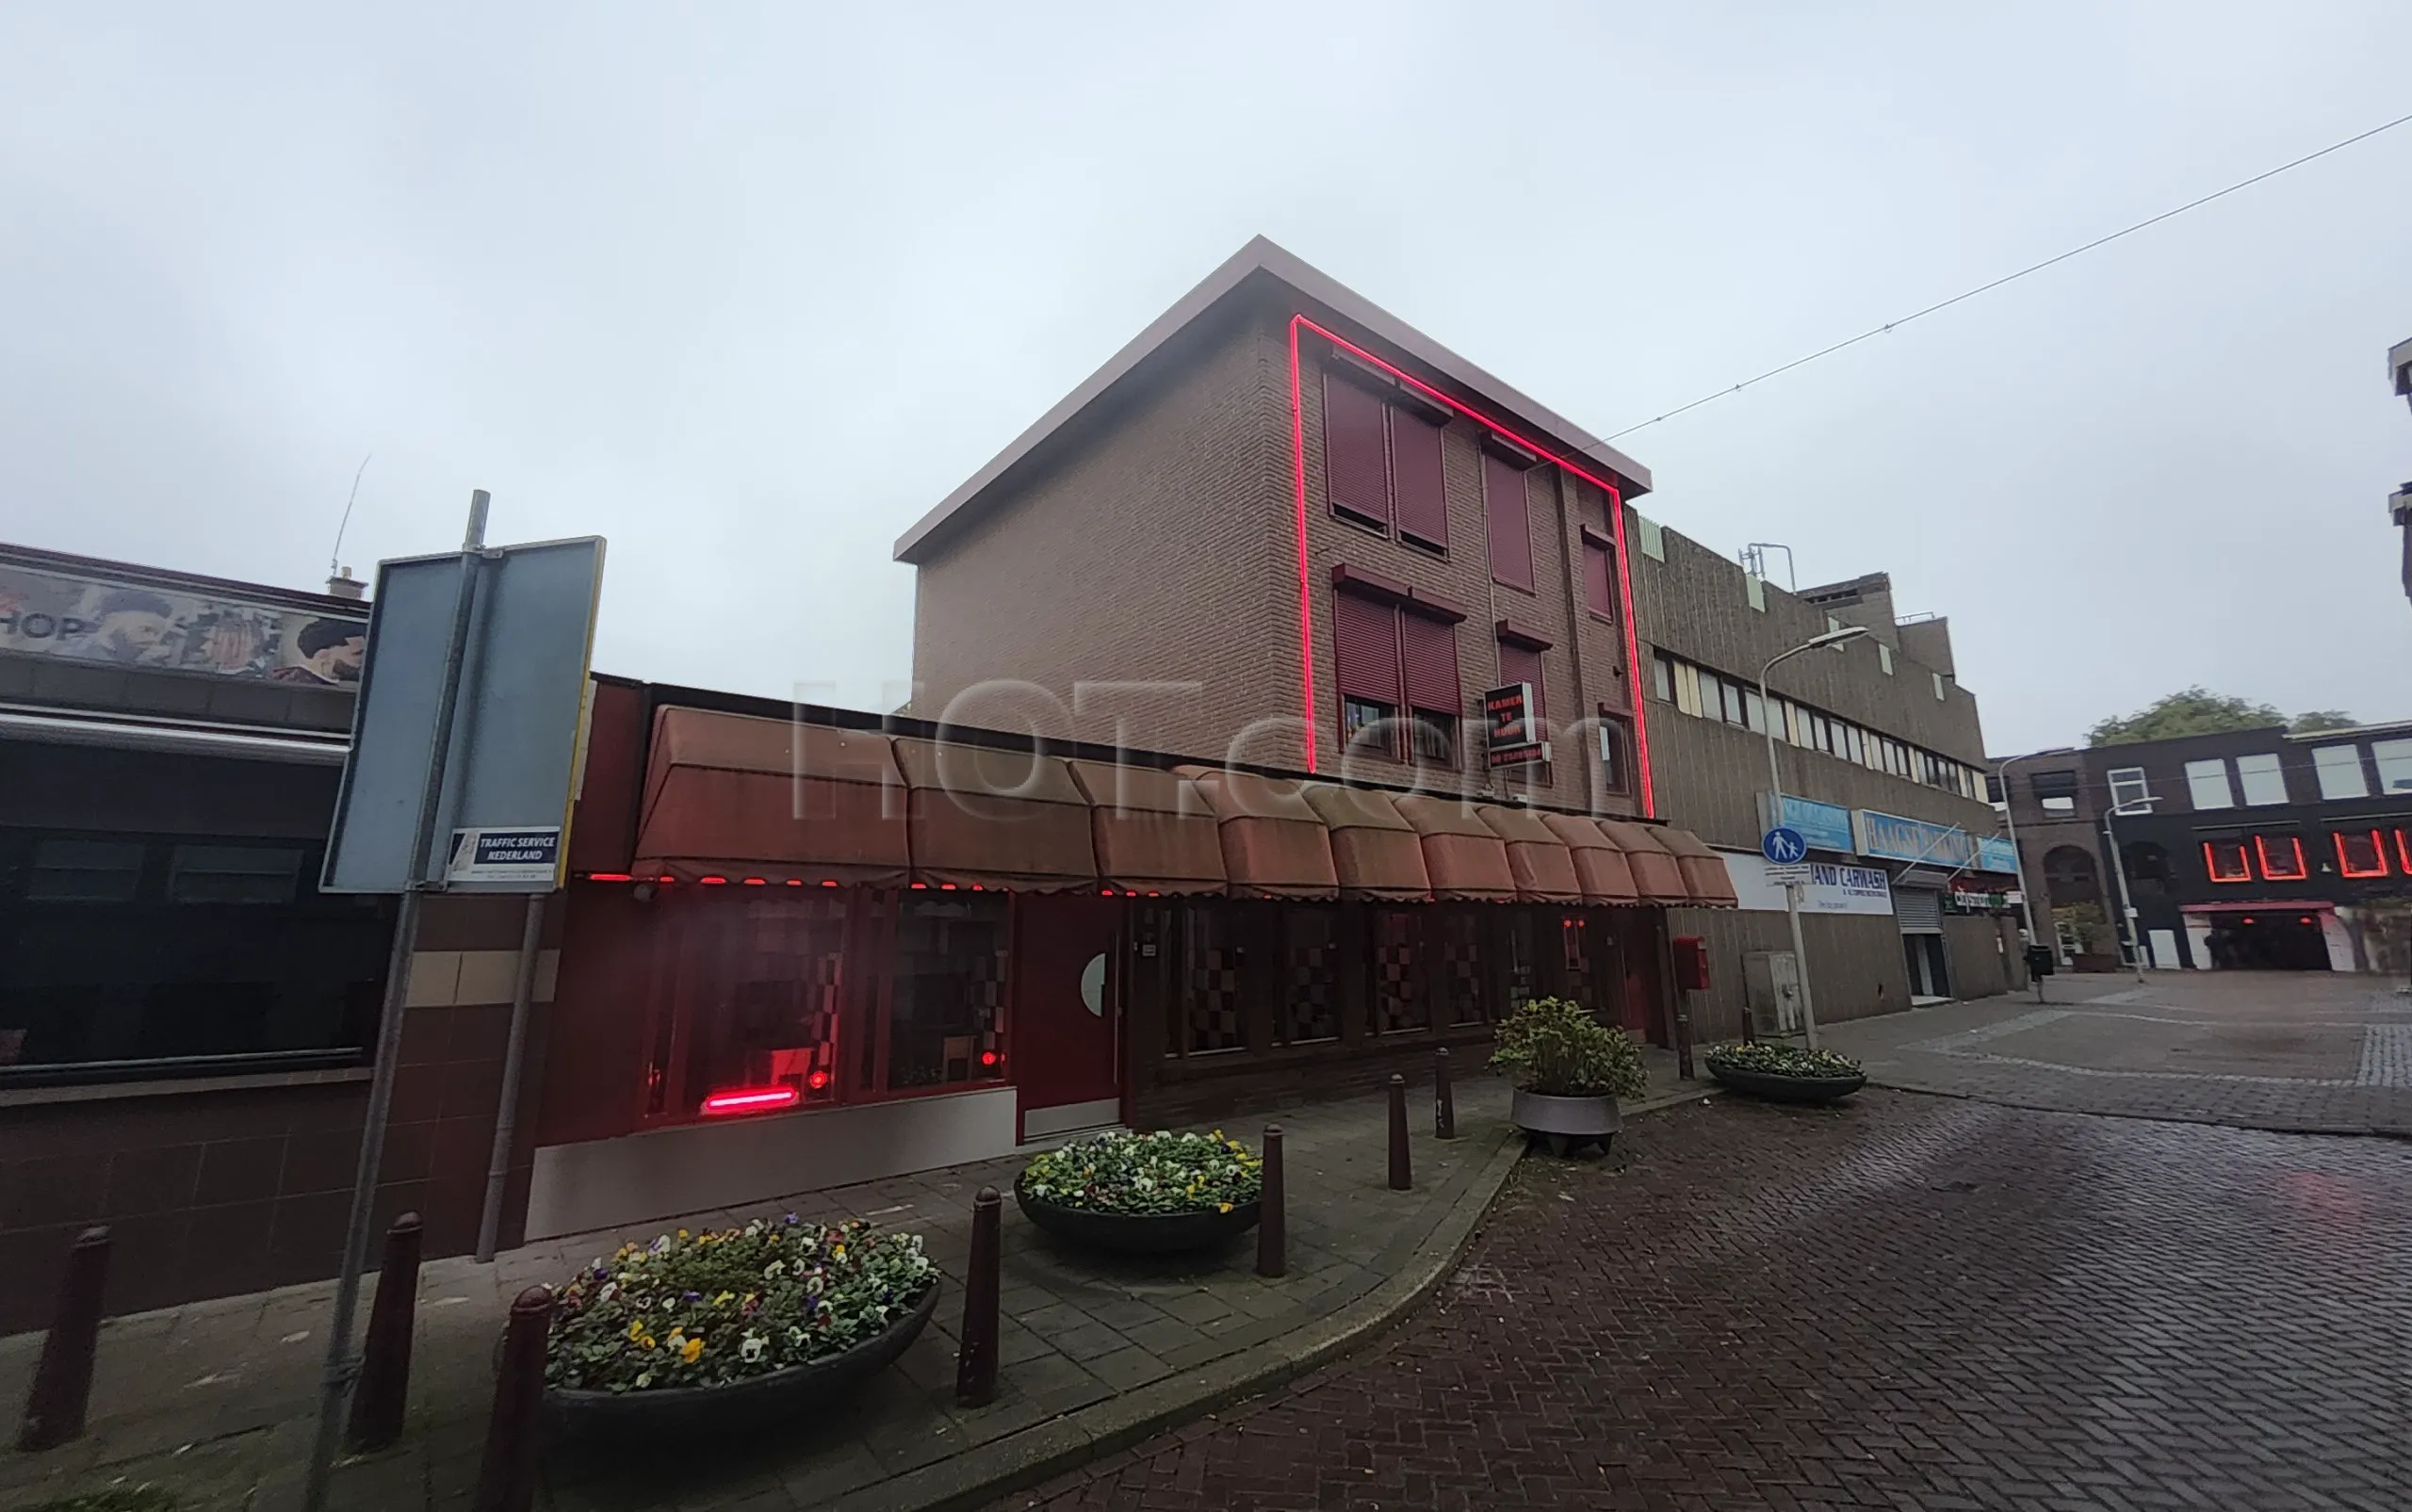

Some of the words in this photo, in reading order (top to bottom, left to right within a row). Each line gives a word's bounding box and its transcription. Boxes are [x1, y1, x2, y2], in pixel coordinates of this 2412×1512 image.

[1488, 694, 1523, 710] KAMER
[1501, 711, 1511, 723] TE
[481, 837, 517, 848] TRAFFIC
[518, 837, 555, 847] SERVICE
[487, 851, 543, 860] NEDERLAND
[1840, 868, 1886, 889] CARWASH
